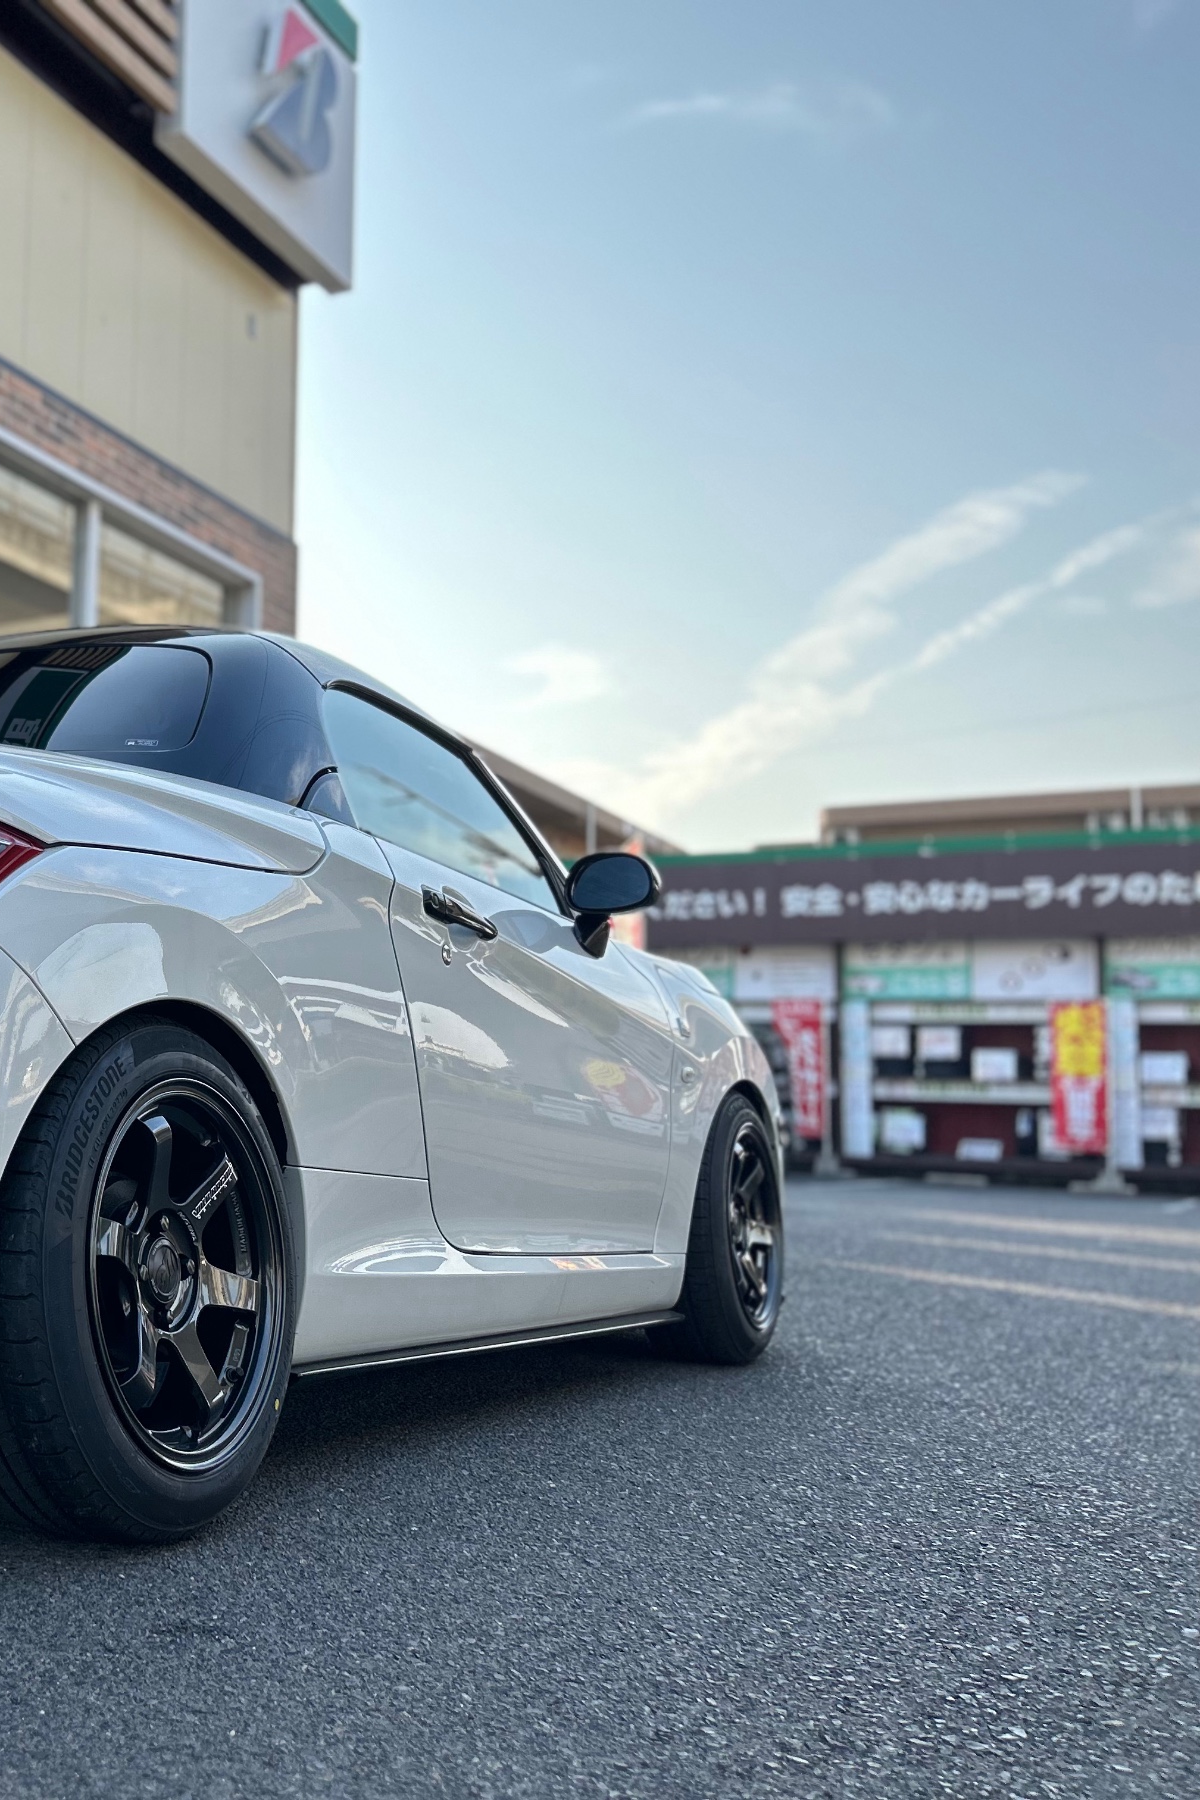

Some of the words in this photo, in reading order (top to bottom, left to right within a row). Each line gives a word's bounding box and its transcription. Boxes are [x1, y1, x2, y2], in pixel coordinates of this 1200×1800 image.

[780, 871, 1200, 916] 安全・安心なカーライフのた
[54, 1056, 127, 1221] BRIDGESTONE
